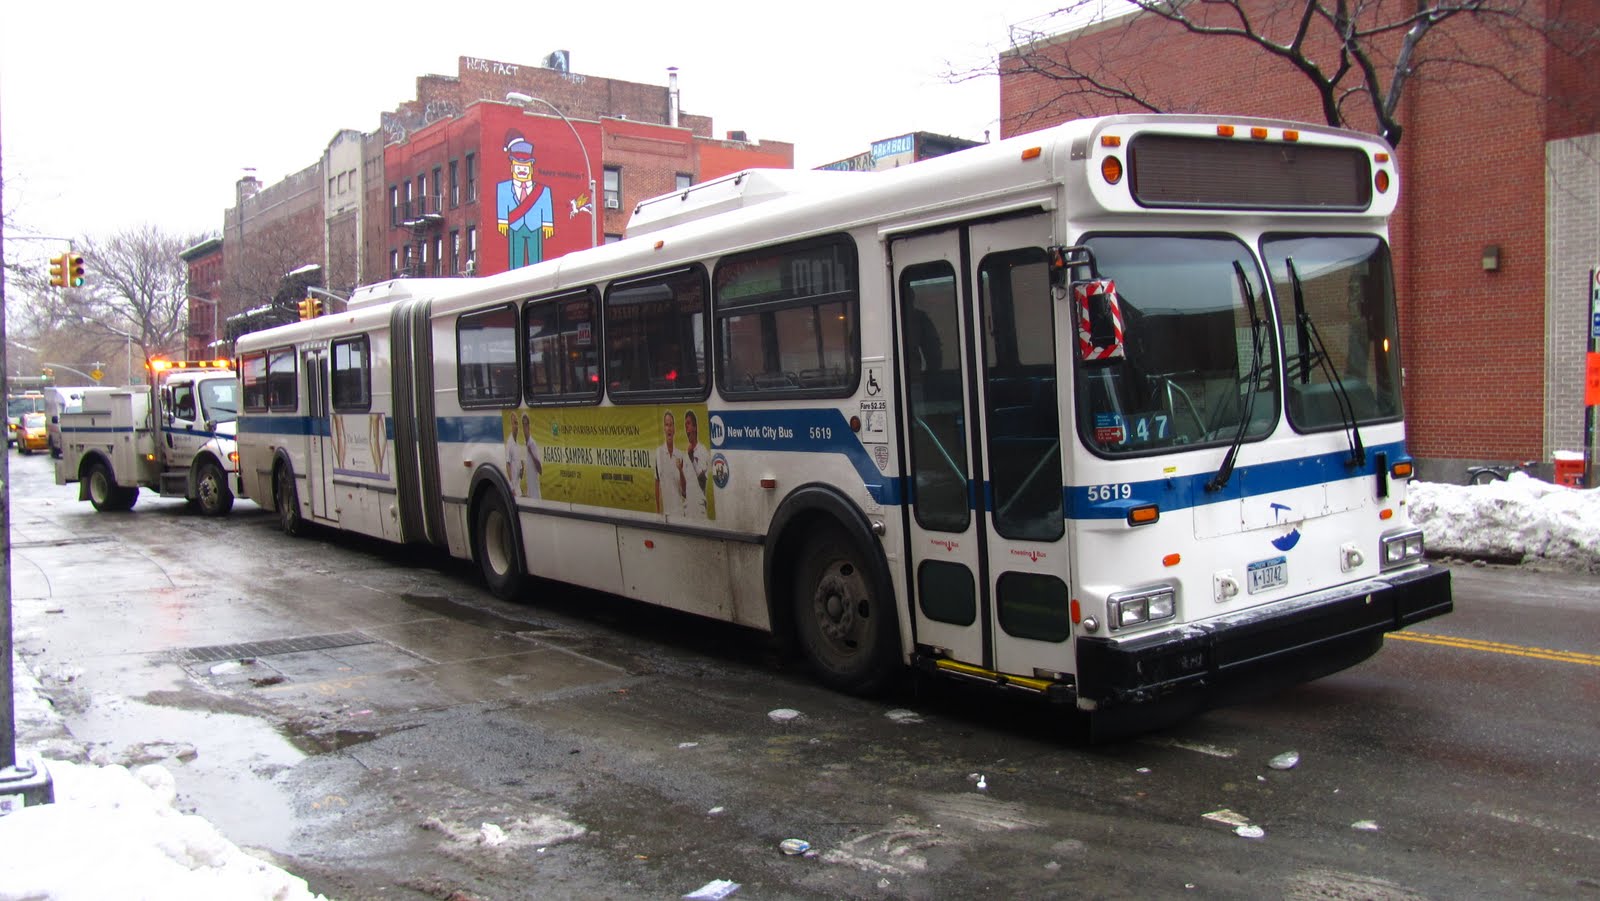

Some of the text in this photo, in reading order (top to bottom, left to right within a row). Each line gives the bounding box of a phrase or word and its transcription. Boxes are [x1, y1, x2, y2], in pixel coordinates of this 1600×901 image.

[493, 62, 519, 76] FACT
[573, 425, 597, 436] PARIBAS
[598, 425, 640, 436] SHOWDOWN
[710, 422, 723, 439] MTA
[727, 426, 794, 440] New York City Bus
[809, 427, 832, 439] 5619
[543, 446, 652, 468] AGASSI SAMPRAS McENROE LENDL
[1087, 483, 1132, 501] 5619
[1011, 549, 1032, 557] Kneeling
